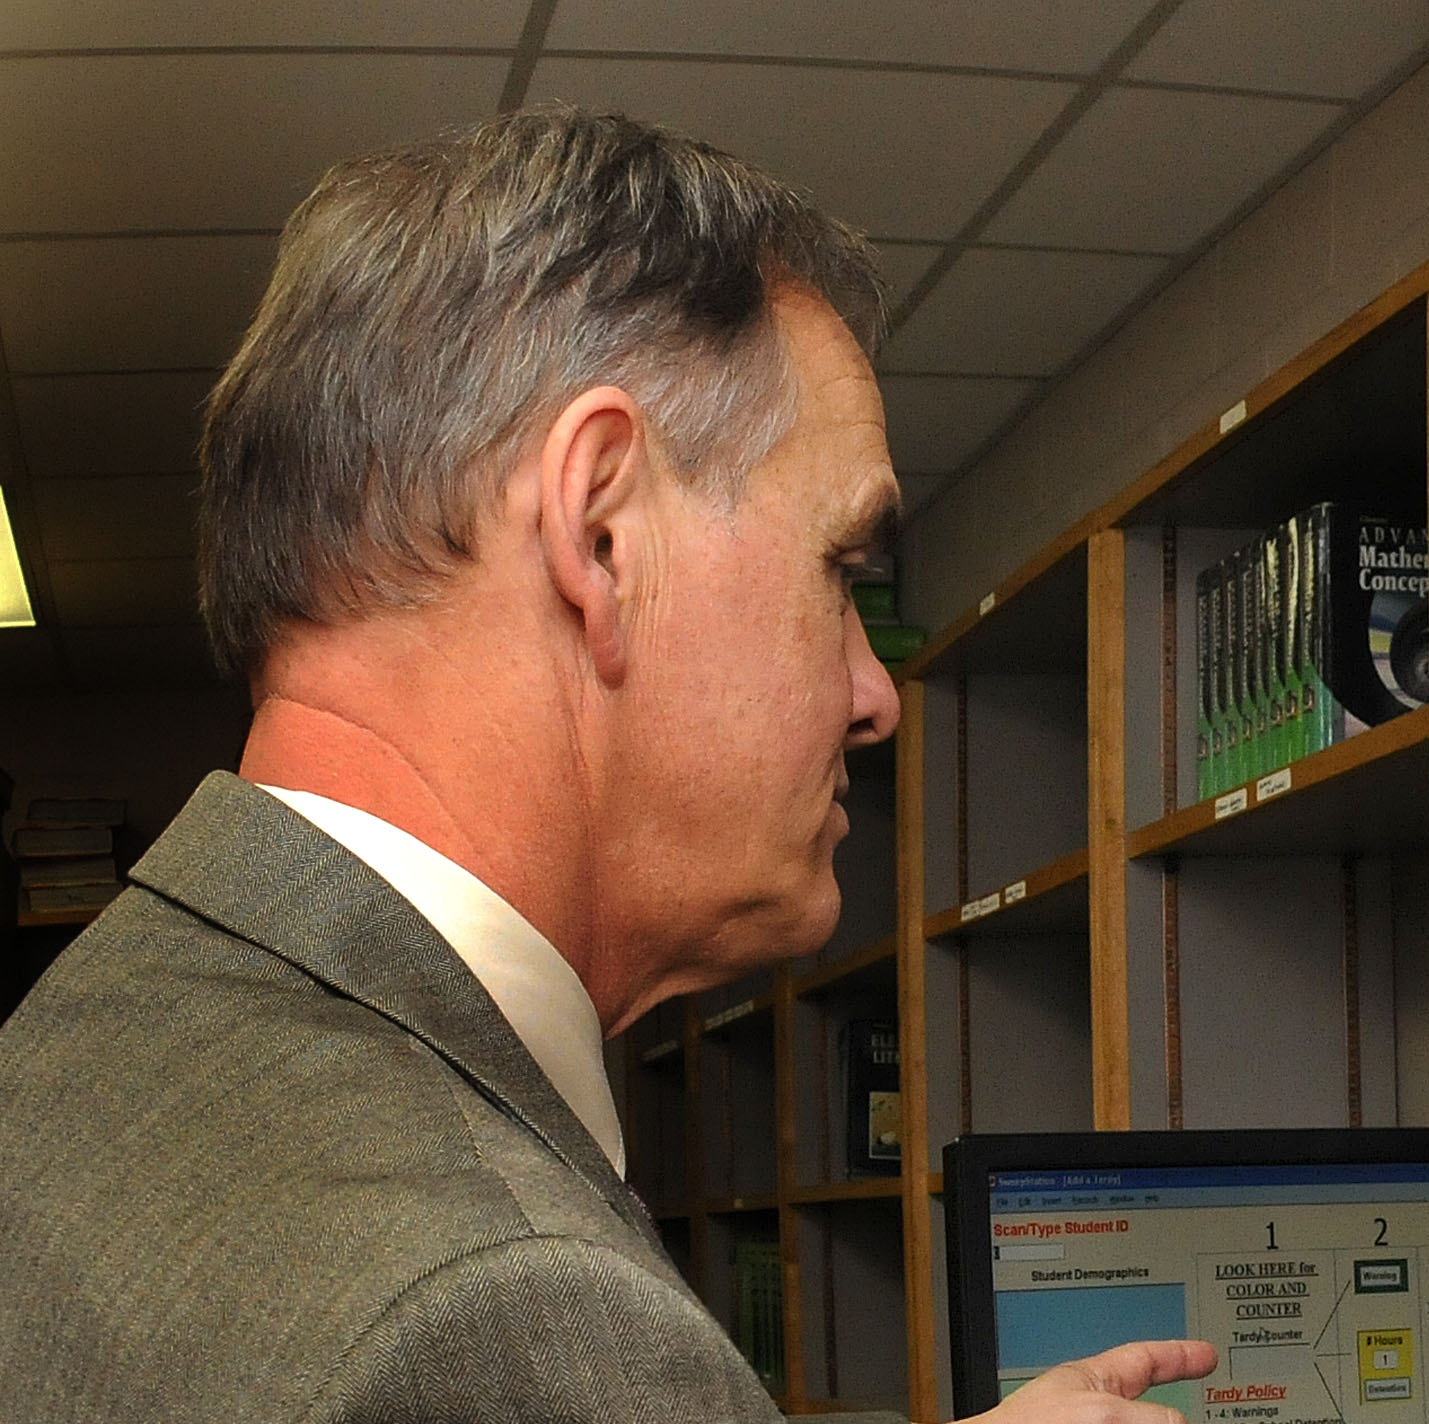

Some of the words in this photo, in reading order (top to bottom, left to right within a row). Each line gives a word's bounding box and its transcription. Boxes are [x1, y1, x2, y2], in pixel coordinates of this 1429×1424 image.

[993, 1221, 1062, 1238] Scan/Type
[1065, 1220, 1113, 1235] Student
[1116, 1219, 1129, 1232] ID
[1266, 1221, 1279, 1250] 1
[1374, 1218, 1388, 1246] 2
[1031, 1268, 1073, 1282] Student
[1074, 1267, 1149, 1282] Demographics
[1215, 1263, 1255, 1277] LOOK
[1259, 1261, 1296, 1275] HERE
[1299, 1261, 1316, 1274] for
[1226, 1282, 1275, 1297] COLOR
[1278, 1282, 1306, 1295] AND
[1236, 1302, 1302, 1317] COUNTER
[1232, 1331, 1262, 1343] Tardy
[1374, 1335, 1402, 1345] Hours
[1206, 1386, 1243, 1401] Tardy
[1247, 1384, 1287, 1399] Policy
[1231, 1406, 1279, 1419] Warnings
